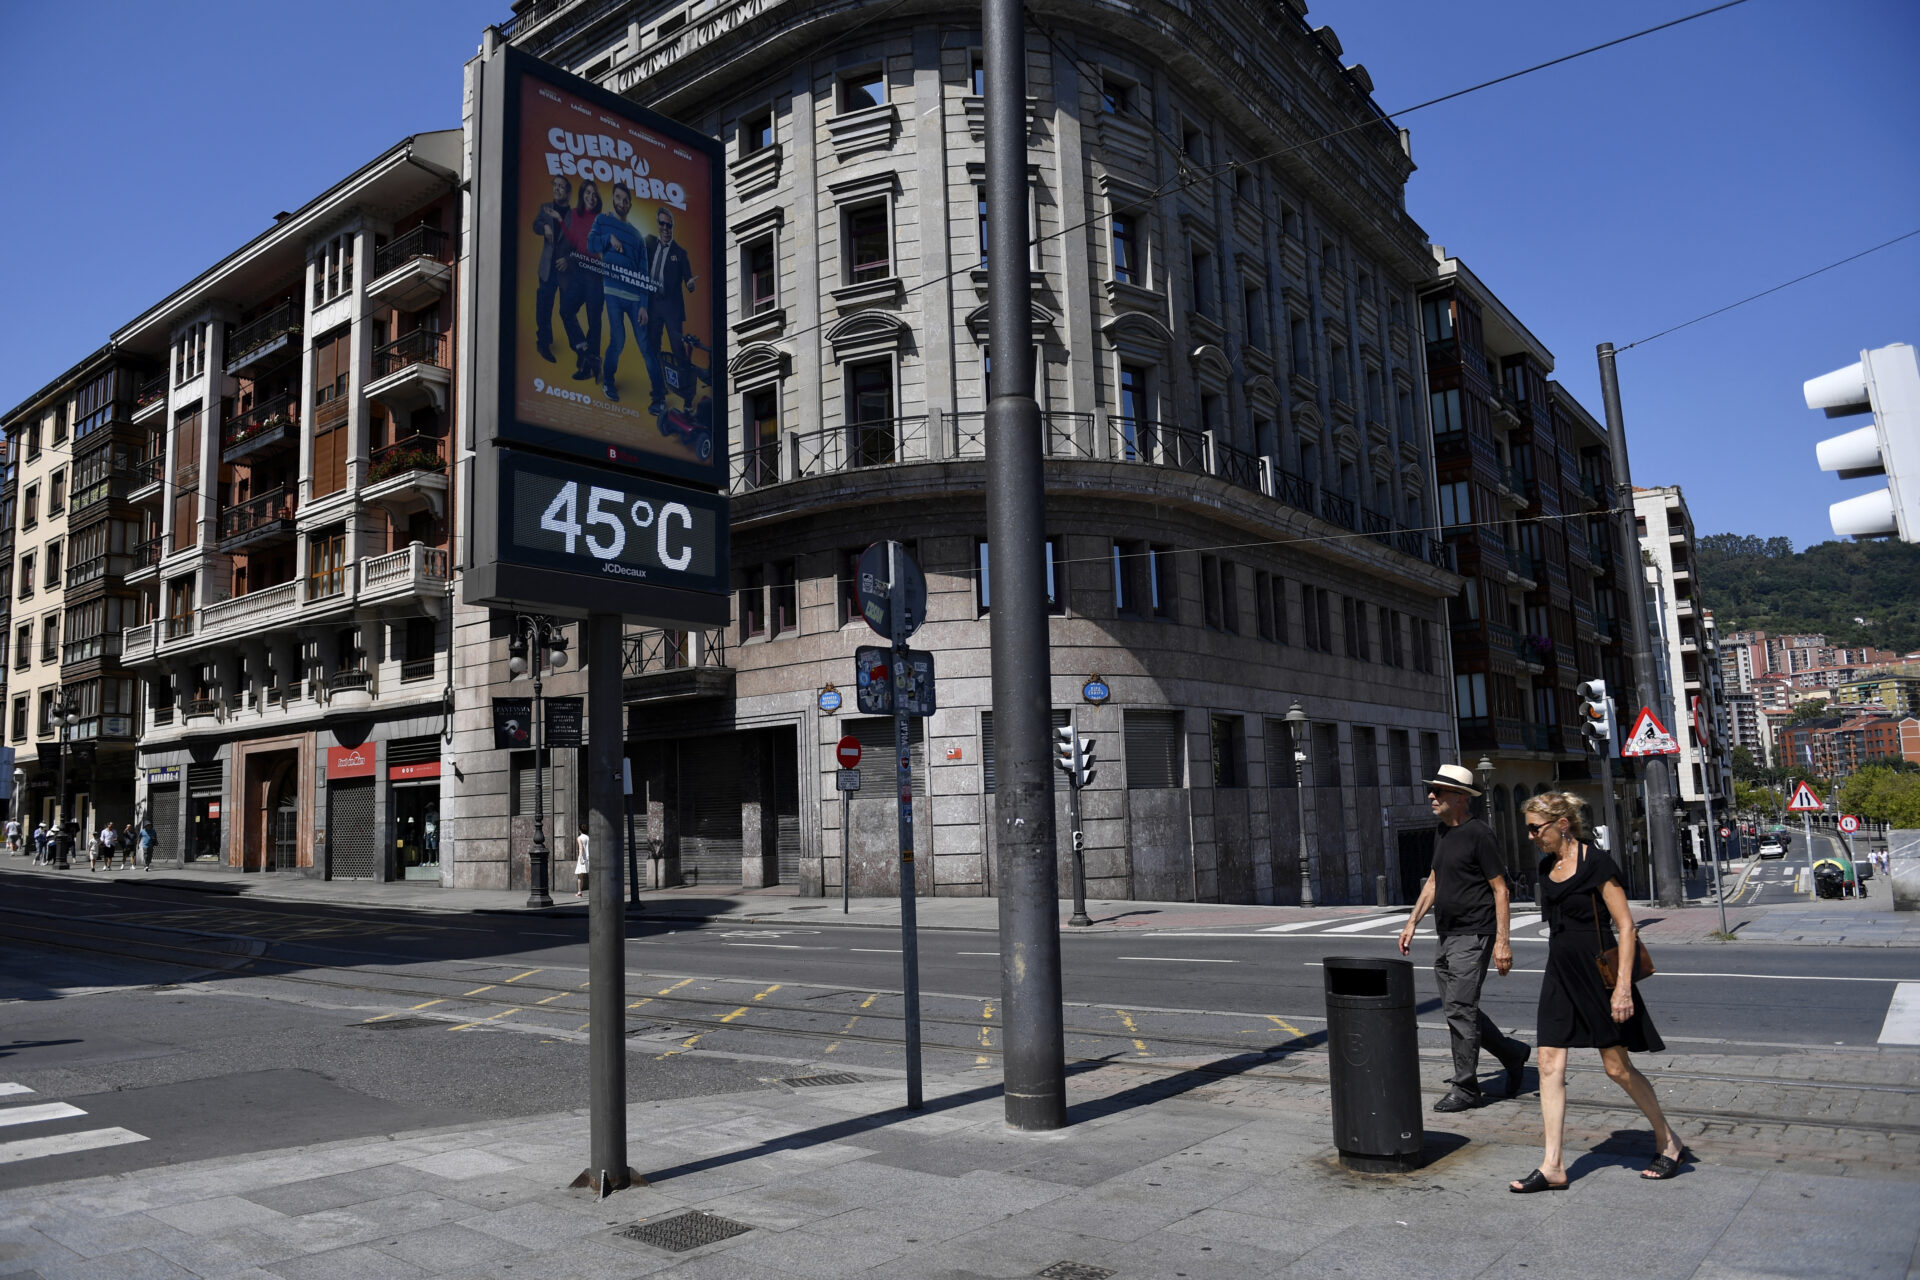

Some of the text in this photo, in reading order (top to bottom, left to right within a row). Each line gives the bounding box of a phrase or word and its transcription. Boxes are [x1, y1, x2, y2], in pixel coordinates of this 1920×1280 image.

[544, 152, 687, 211] ESCOMBRO
[611, 263, 650, 283] LLEGARÍAS
[533, 377, 545, 392] 9
[545, 385, 592, 405] AGOSTO
[540, 480, 693, 571] 45°C
[602, 562, 647, 579] JCDecaux
